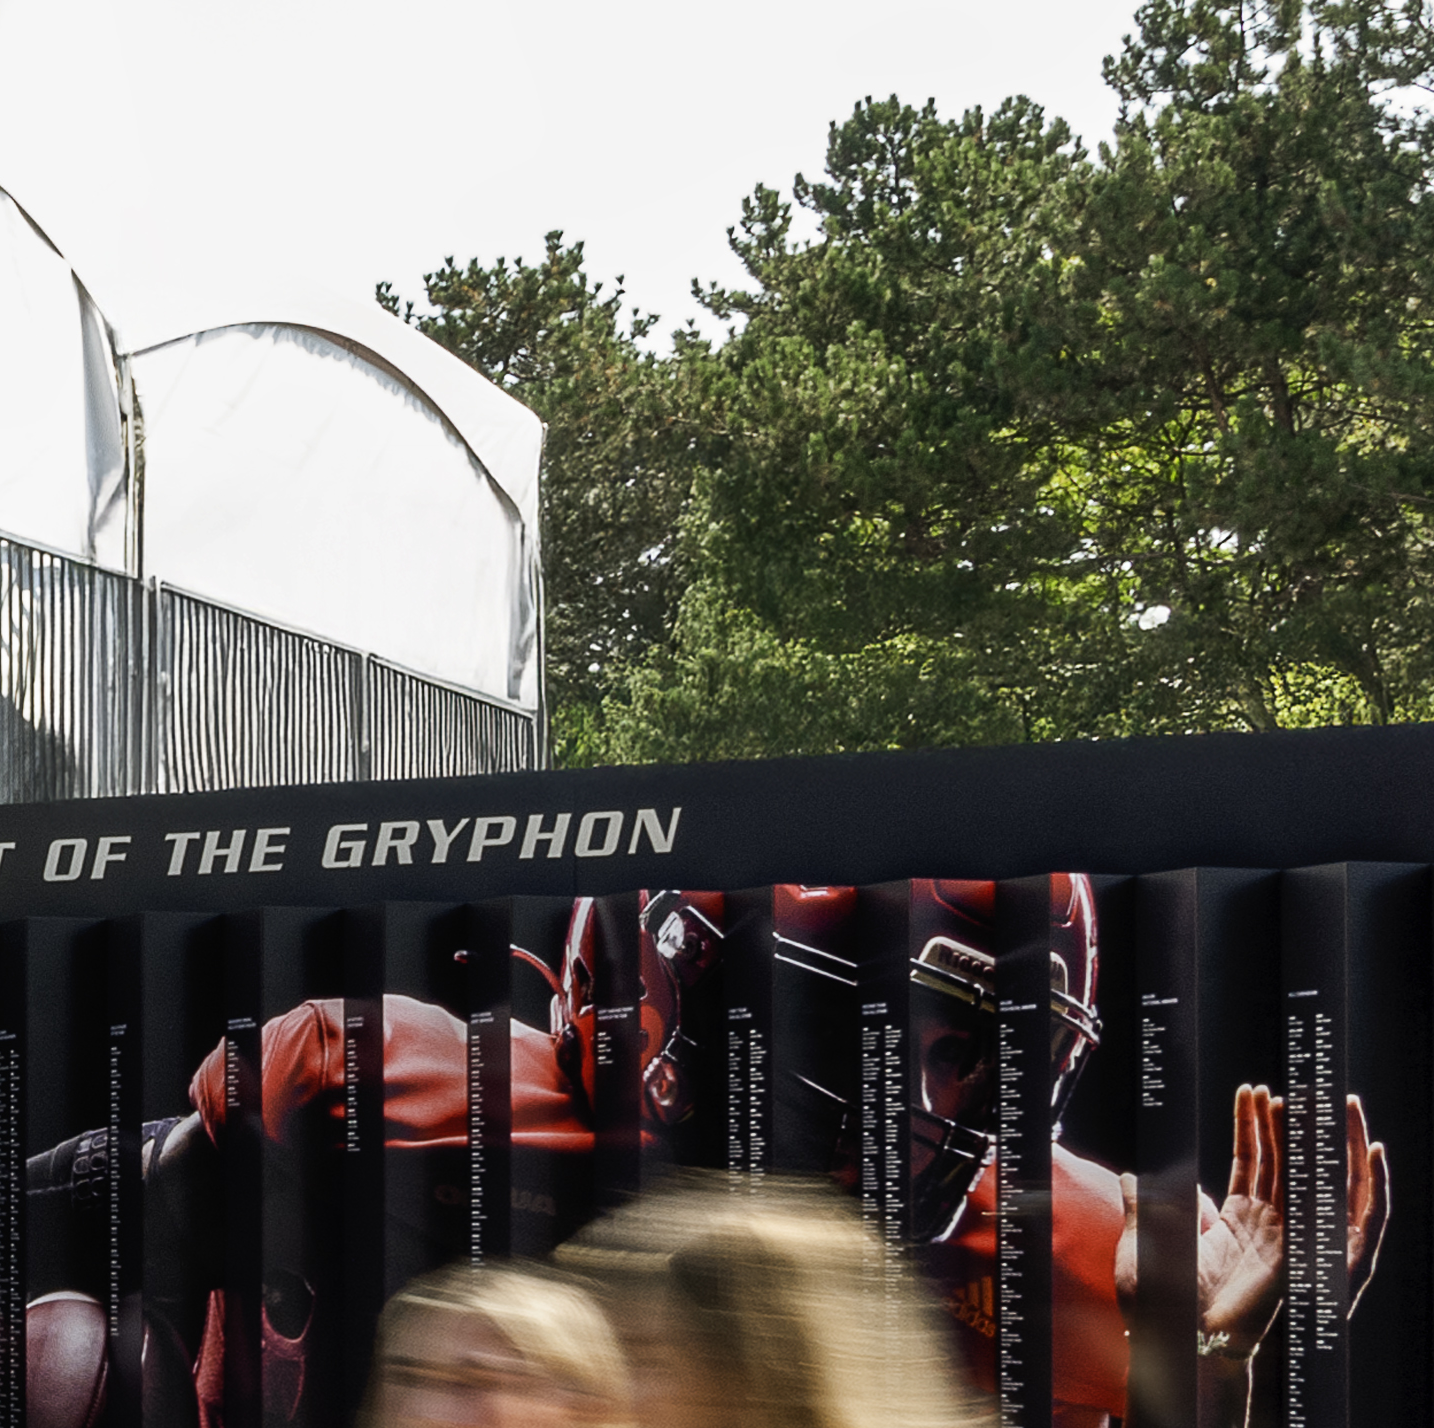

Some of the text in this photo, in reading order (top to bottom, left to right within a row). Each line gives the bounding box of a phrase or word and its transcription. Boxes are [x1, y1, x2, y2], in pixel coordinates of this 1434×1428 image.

[43, 835, 132, 882] OF
[164, 826, 291, 876] THE
[321, 807, 682, 869] GRYPHON
